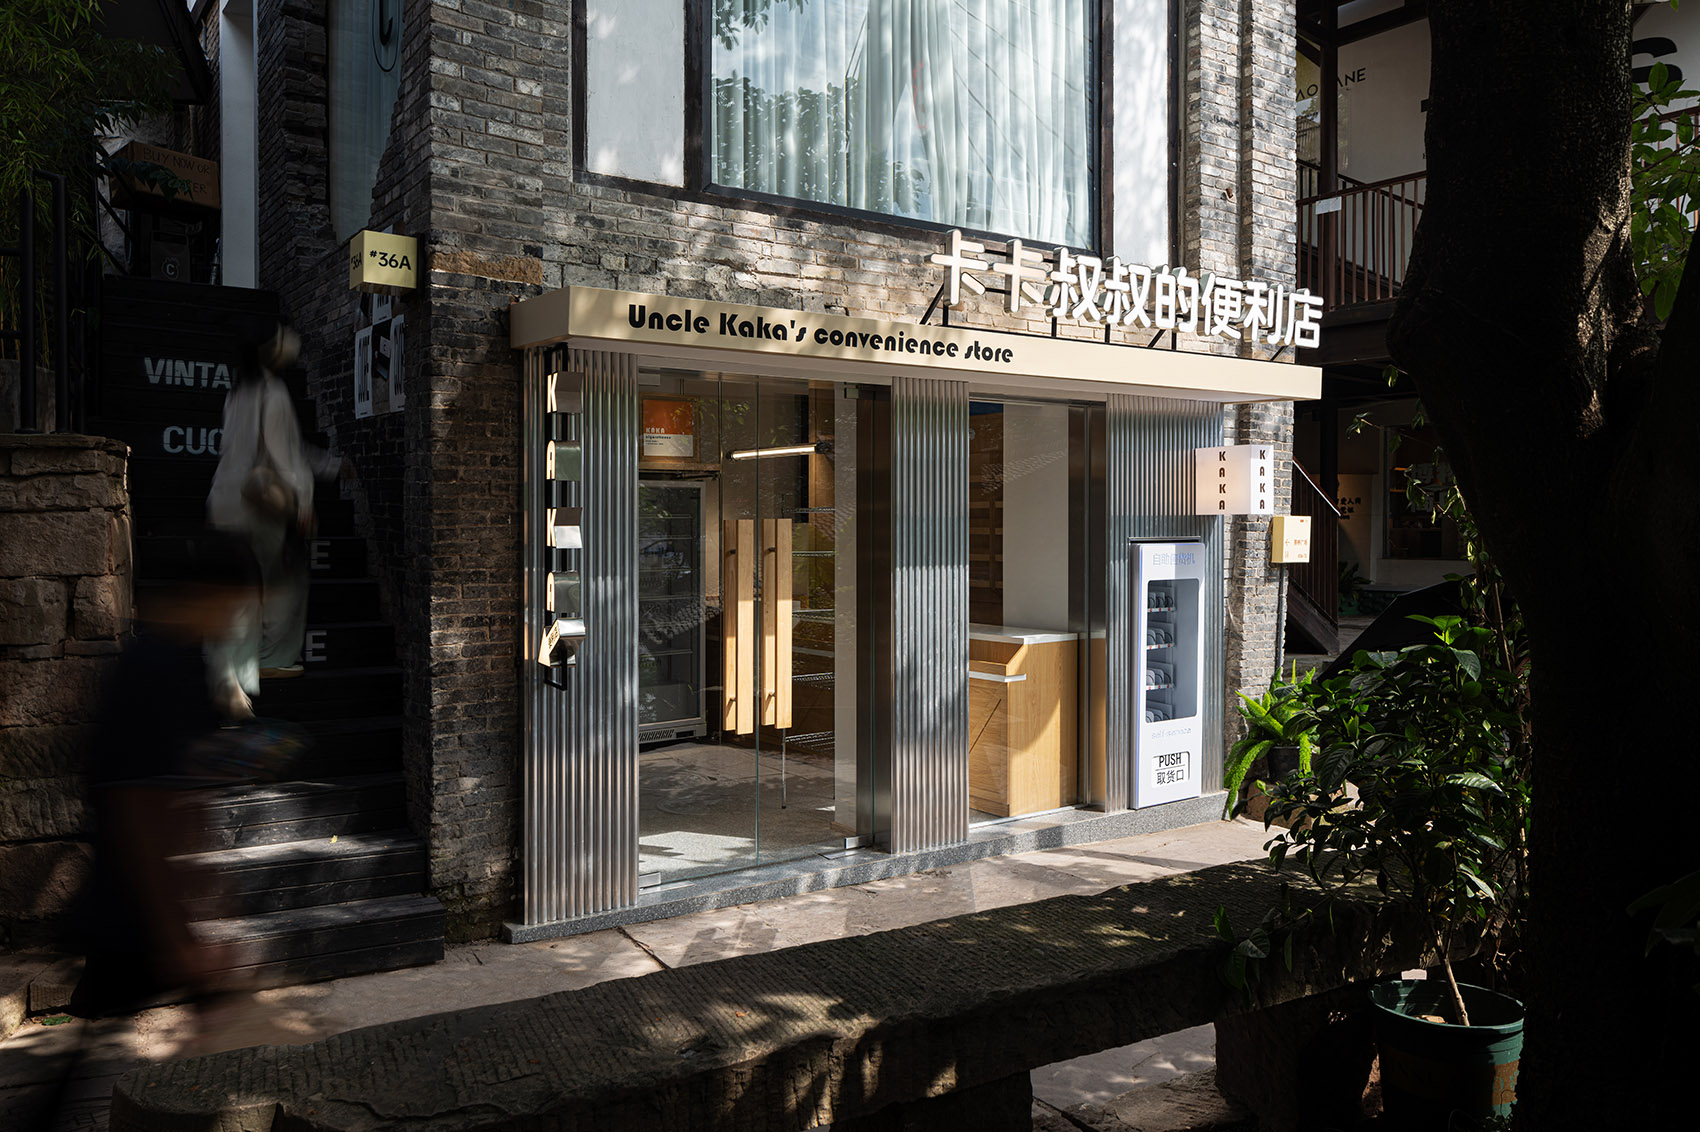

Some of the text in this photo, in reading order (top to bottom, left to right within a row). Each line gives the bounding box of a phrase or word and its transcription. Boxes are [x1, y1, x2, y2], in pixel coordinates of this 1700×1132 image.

[143, 147, 211, 176] BUY NOW OR
[369, 249, 412, 271] #36A
[928, 229, 1324, 349] 卡卡叔叔的便利店
[628, 303, 1014, 364] Uncle Kaka's convenience store
[144, 357, 236, 388] VINTA
[1158, 752, 1182, 768] PUSH
[1156, 769, 1185, 785] 取货口
